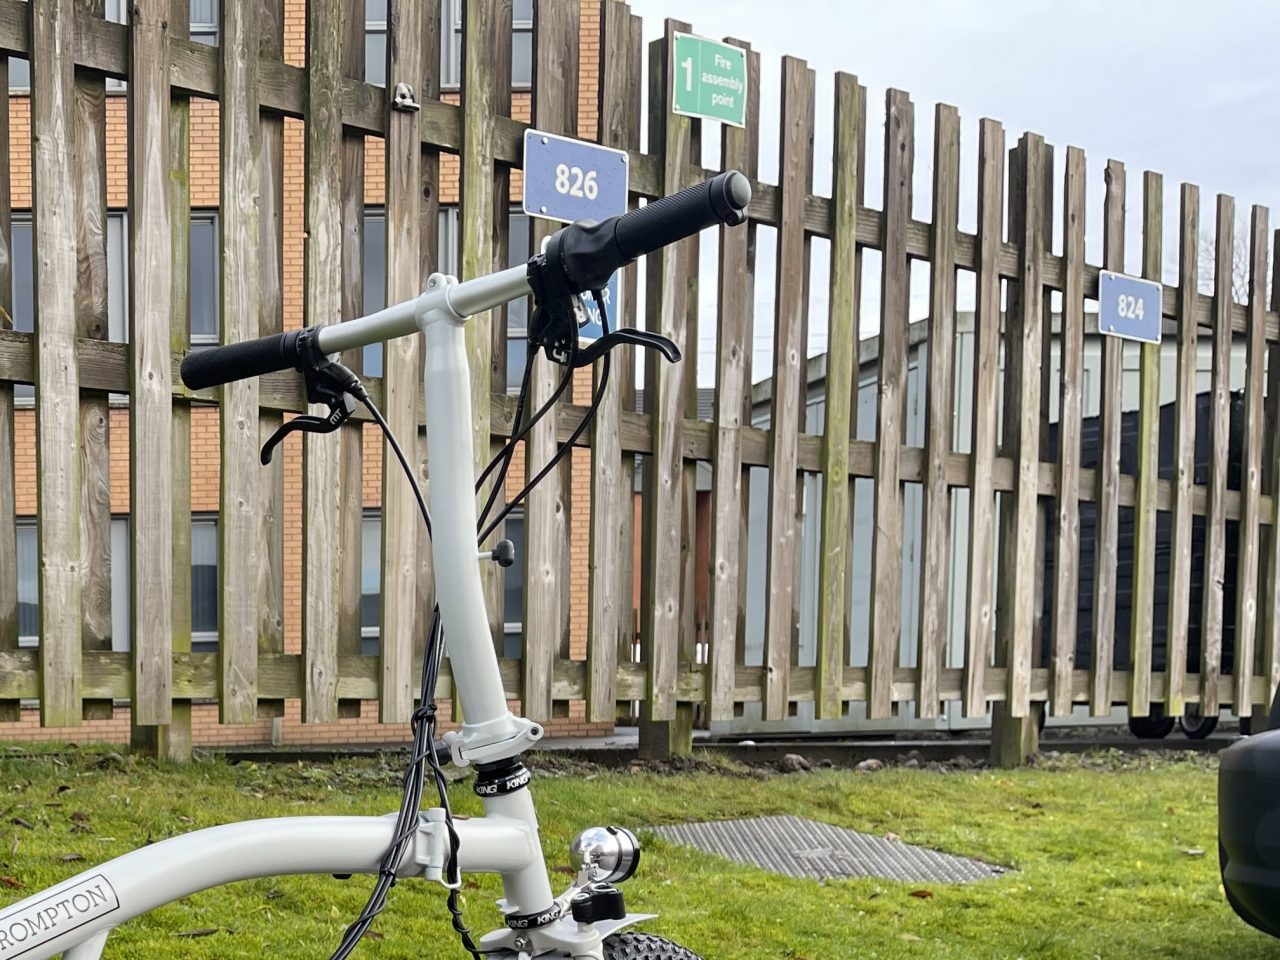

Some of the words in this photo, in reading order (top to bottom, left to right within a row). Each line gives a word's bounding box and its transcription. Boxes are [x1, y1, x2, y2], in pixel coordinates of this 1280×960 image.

[714, 53, 731, 70] Fire
[681, 56, 692, 91] 1
[701, 72, 743, 94] assembly
[711, 93, 733, 108] point
[555, 163, 598, 200] 826
[1118, 294, 1144, 320] 824
[476, 784, 498, 794] KING
[506, 771, 529, 790] KING
[508, 919, 529, 928] KING
[537, 911, 559, 925] KING
